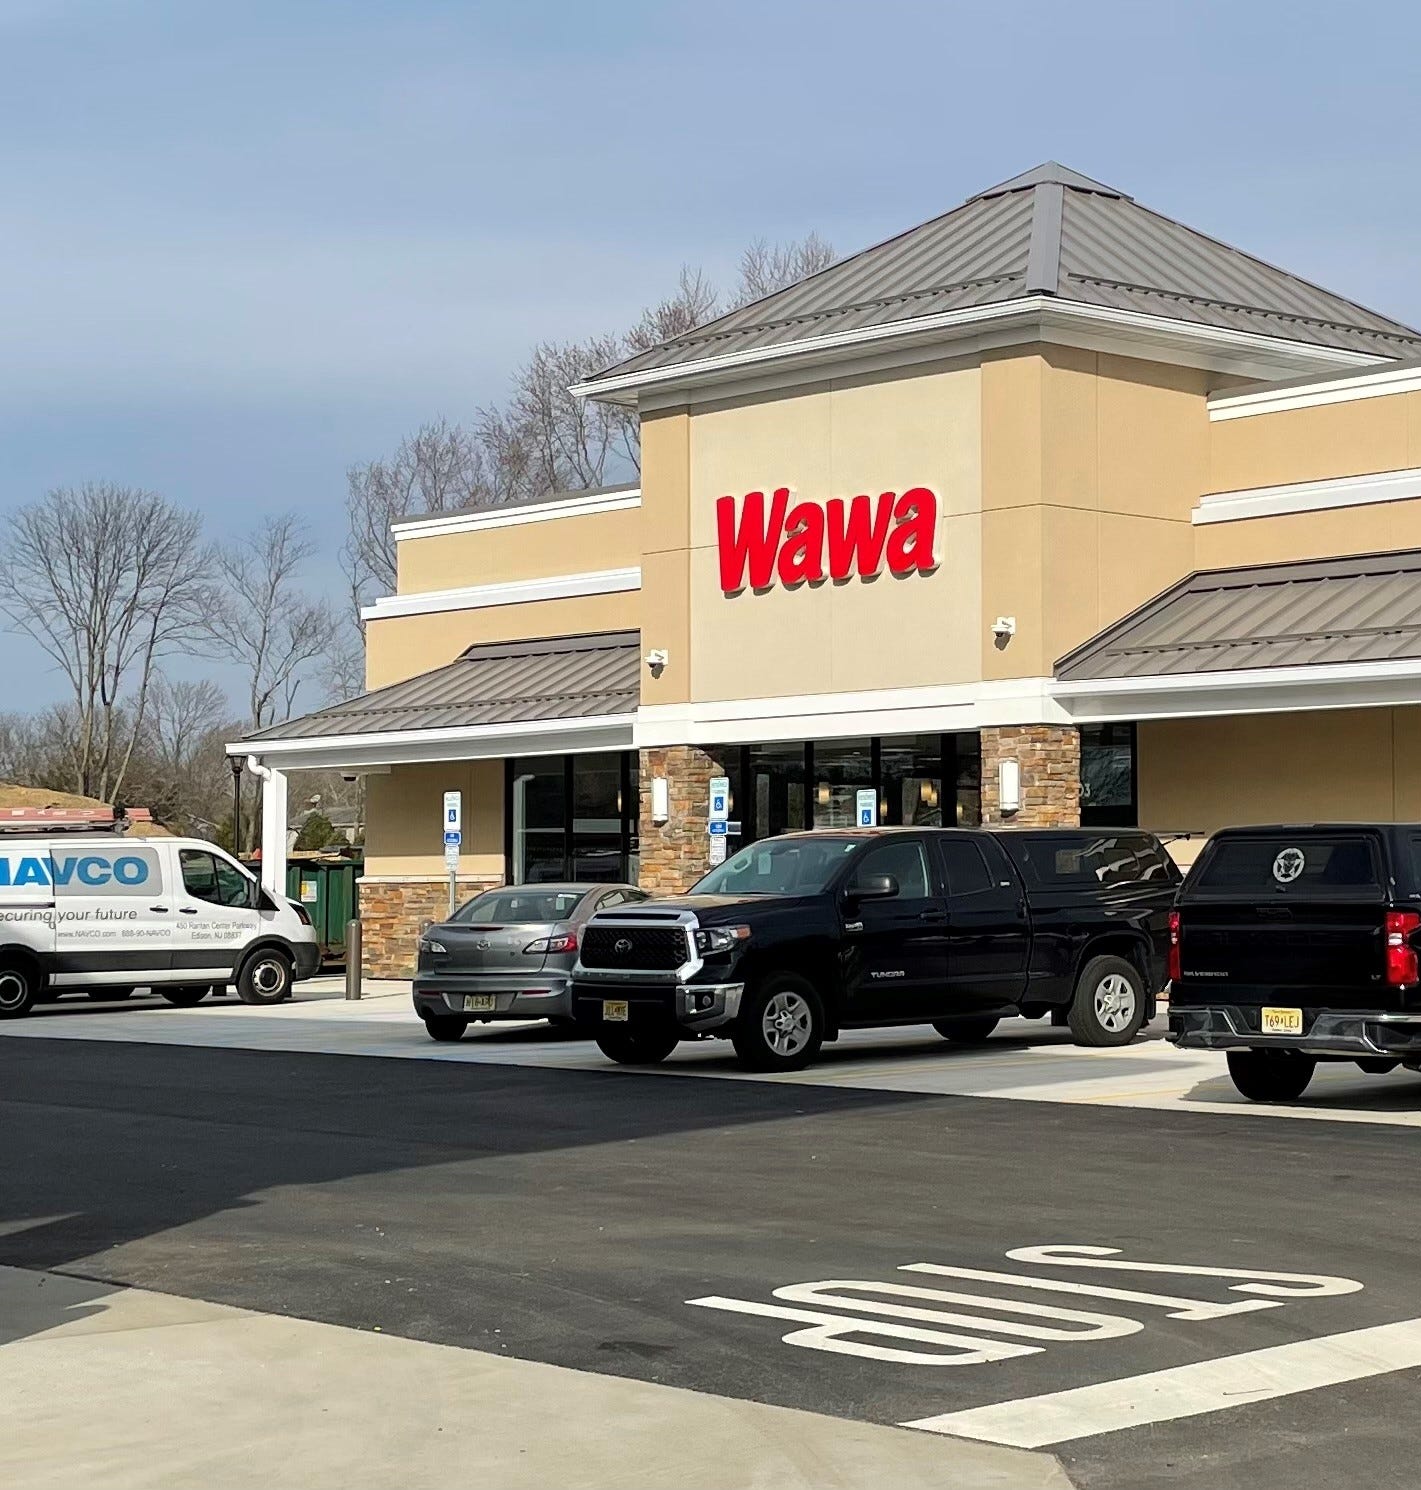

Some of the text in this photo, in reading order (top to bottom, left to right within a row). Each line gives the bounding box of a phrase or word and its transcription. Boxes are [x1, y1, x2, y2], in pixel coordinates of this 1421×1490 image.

[716, 487, 940, 594] Wawa
[58, 910, 93, 924] your
[95, 908, 138, 921] future
[684, 1244, 1365, 1366] STOP
